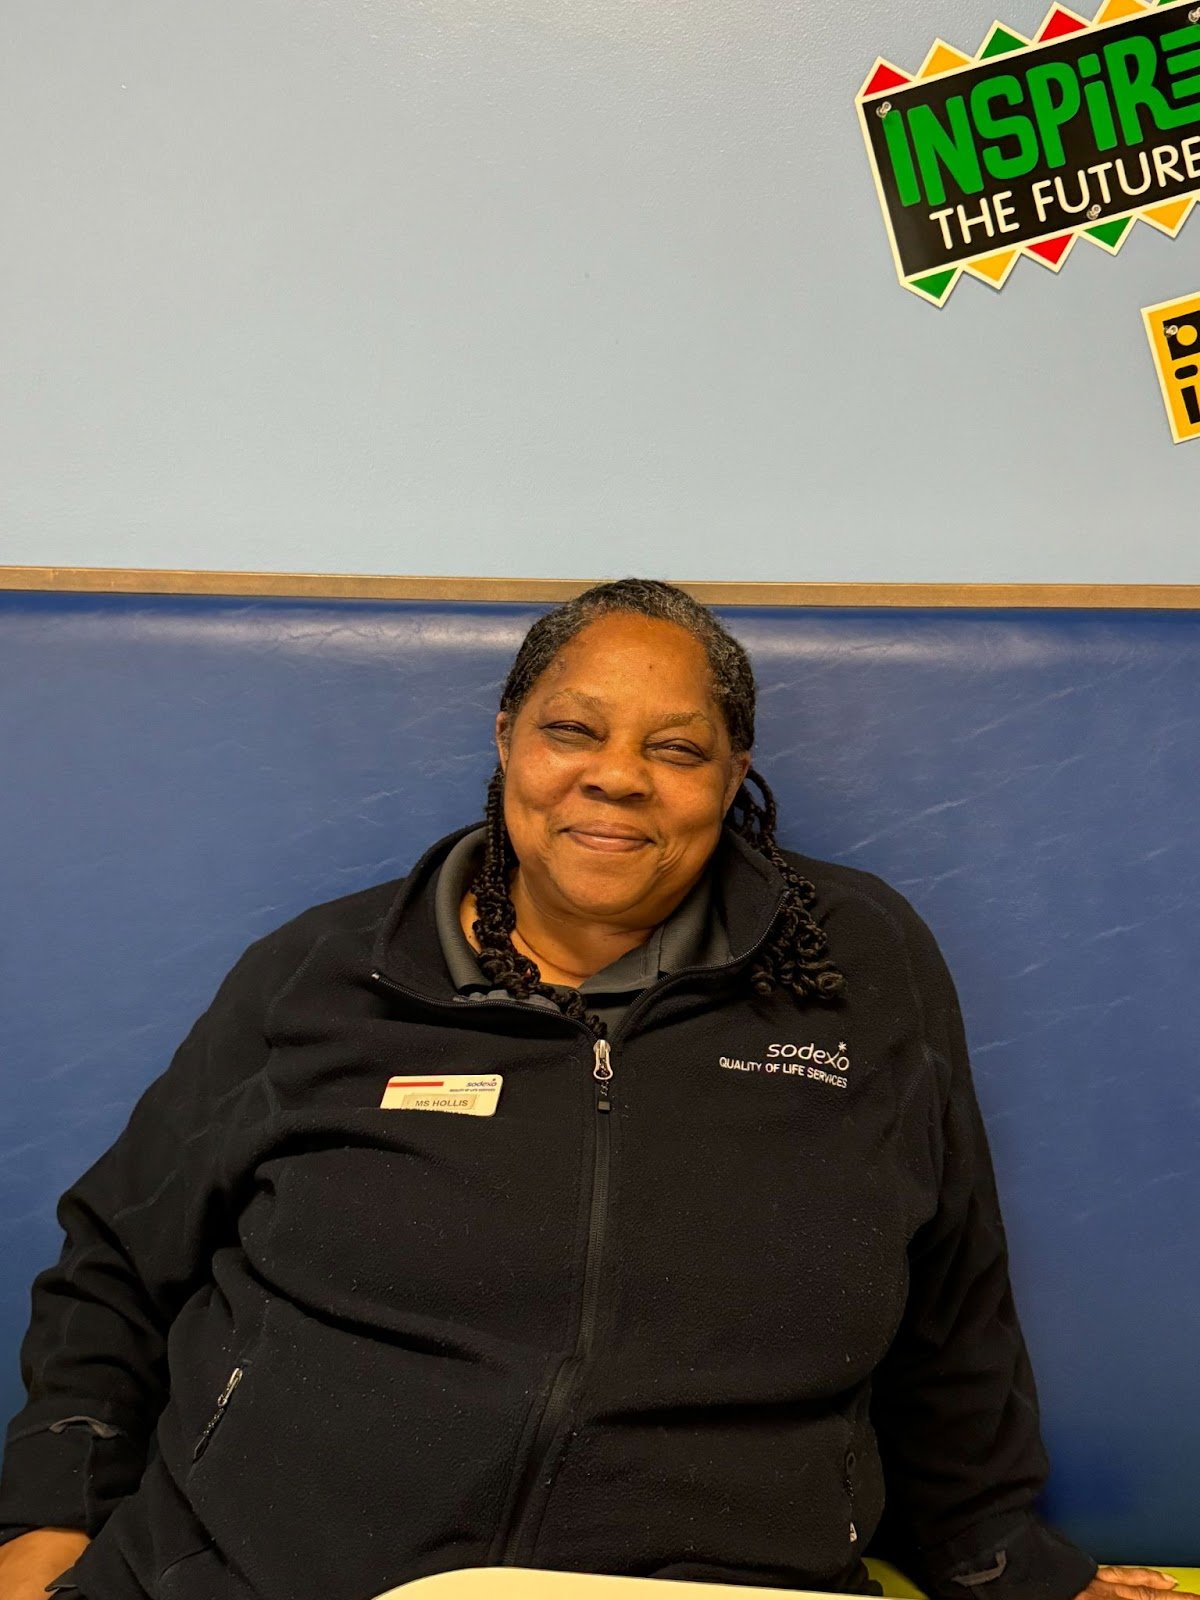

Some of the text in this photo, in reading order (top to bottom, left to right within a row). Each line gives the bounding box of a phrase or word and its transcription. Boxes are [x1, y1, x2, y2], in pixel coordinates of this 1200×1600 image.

[928, 136, 1200, 250] THE FUTURE
[719, 1056, 848, 1089] QUALITY OF LIFE SERVICES
[766, 1042, 850, 1071] sodexo
